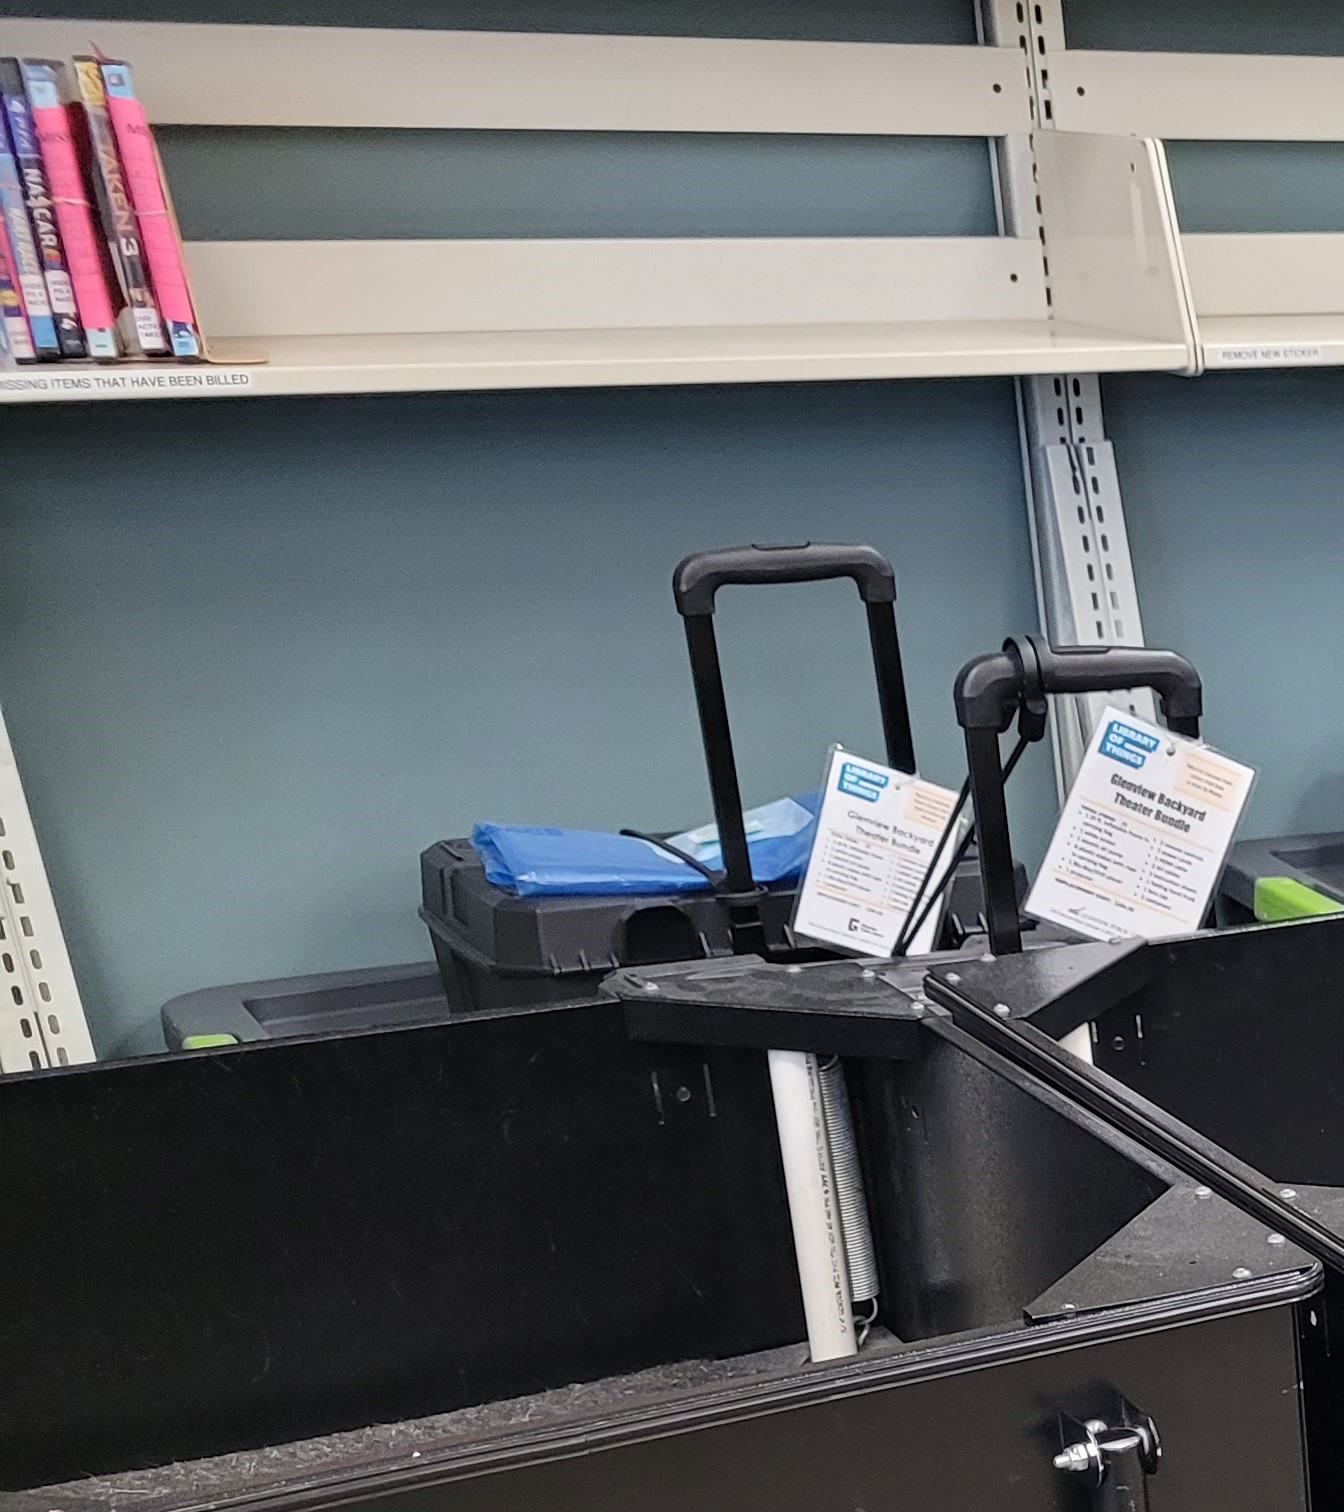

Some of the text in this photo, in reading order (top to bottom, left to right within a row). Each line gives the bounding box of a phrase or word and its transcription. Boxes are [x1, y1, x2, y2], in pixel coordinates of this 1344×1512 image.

[24, 168, 58, 247] NASCAR
[120, 237, 139, 256] 3
[0, 373, 250, 390] ISSING ITEMS THAT HAVE BEEN BILLED
[1108, 733, 1125, 746] OF
[1112, 723, 1157, 749] LIBRARY
[1105, 742, 1144, 767] THINGS
[1110, 773, 1156, 802] Glenview
[1157, 792, 1207, 823] Backyard
[1114, 791, 1154, 818] Theater
[1154, 809, 1192, 834] Bundle
[847, 810, 934, 847] Glenview Backyard
[856, 825, 920, 855] Theater Bundle
